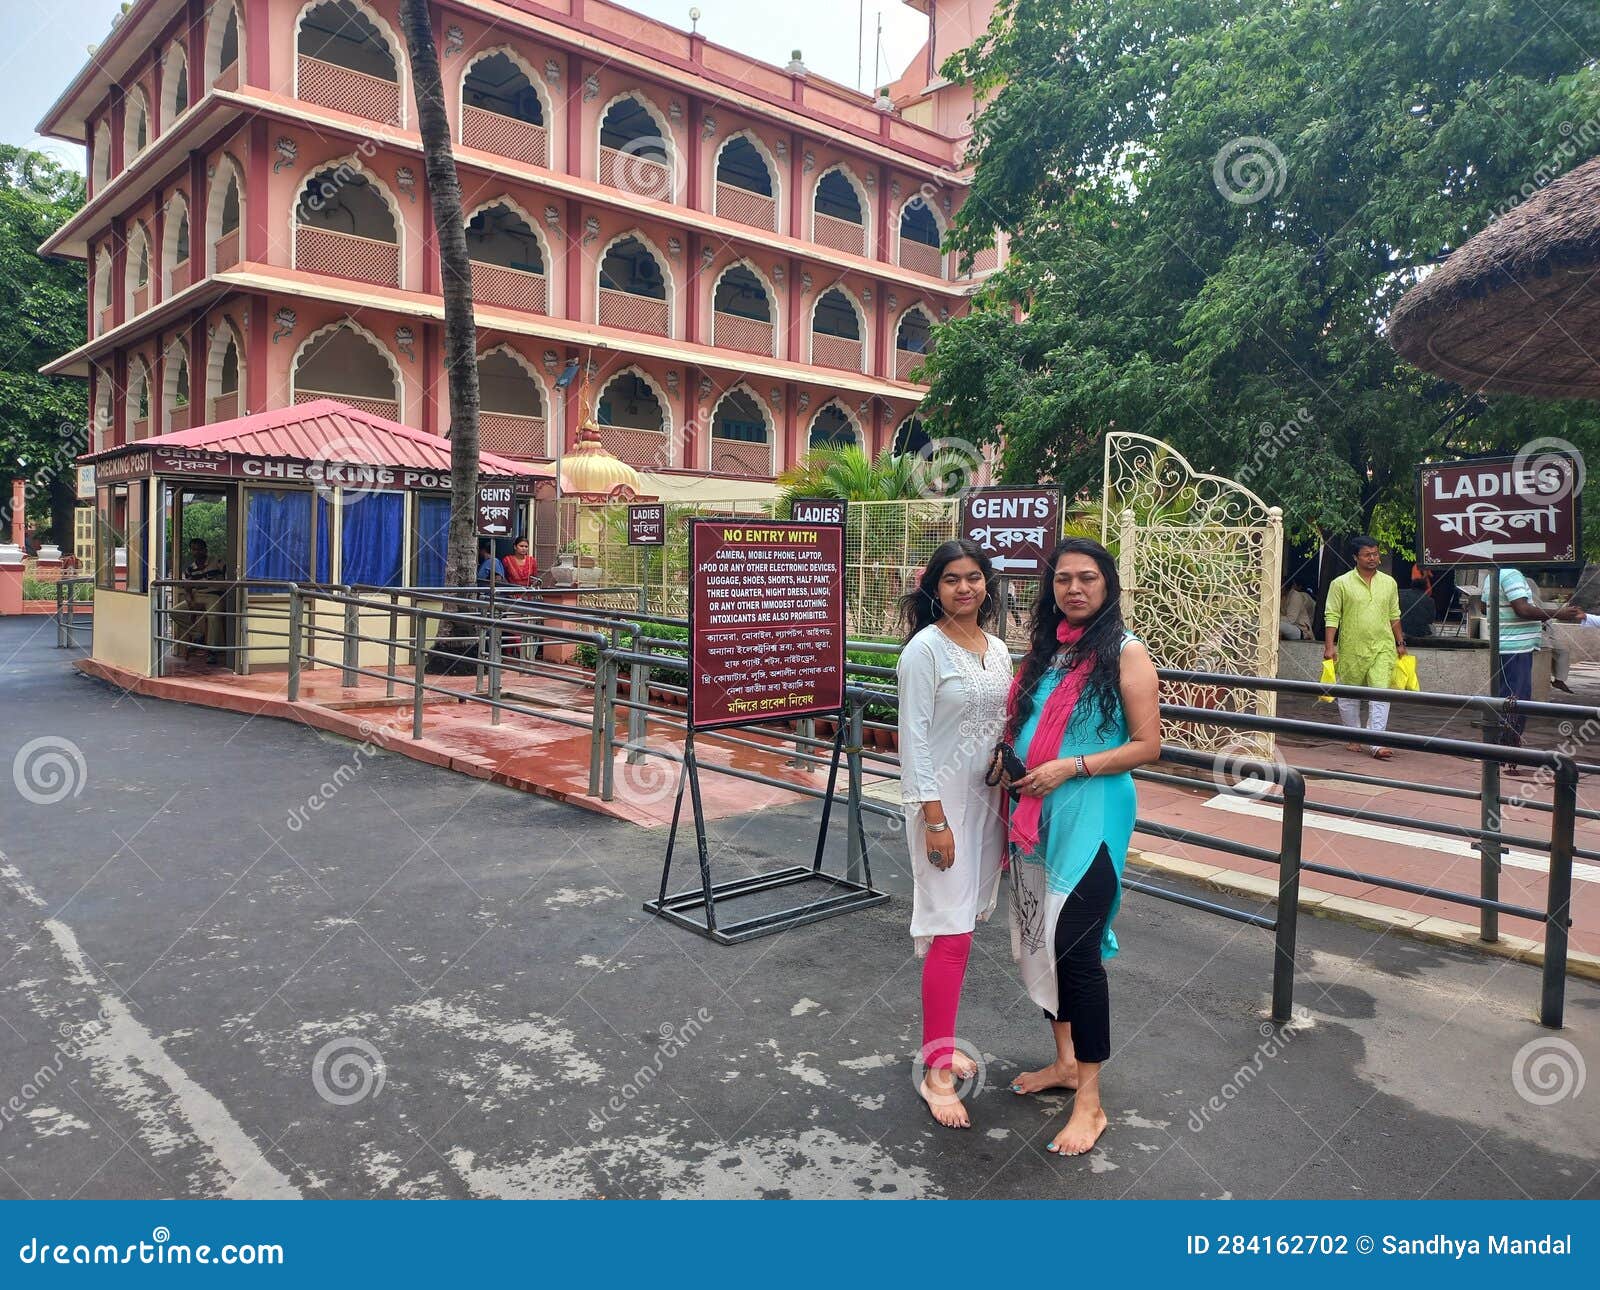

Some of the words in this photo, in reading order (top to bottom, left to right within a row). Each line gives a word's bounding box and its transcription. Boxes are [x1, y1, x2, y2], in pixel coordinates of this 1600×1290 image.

[96, 456, 130, 478] CHECKING
[130, 452, 149, 472] POST
[242, 460, 395, 484] CHECKING
[404, 472, 452, 488] POS
[1434, 468, 1560, 500] LADIES
[480, 488, 510, 501] GENTS
[480, 505, 510, 522] পুরুষ
[798, 506, 840, 522] LADIES
[971, 497, 1049, 518] GENTS
[632, 510, 660, 520] LADIES
[1432, 502, 1562, 538] মহিলা
[632, 521, 660, 534] মহিলা
[724, 530, 742, 541] NO
[746, 530, 784, 542] ENTRY
[788, 532, 817, 542] WITH
[969, 524, 1048, 552] পুরুষ
[716, 550, 746, 560] CAMERA,
[748, 551, 772, 560] MOBILE
[774, 551, 796, 560] PHONE,
[700, 563, 718, 572] I-POD
[719, 563, 728, 572] OR
[730, 564, 745, 572] ANY
[746, 563, 768, 572] OTHER
[770, 564, 808, 572] ELECTRONIC
[810, 563, 837, 573] DEVICES,
[707, 576, 740, 586] LUGGAGE,
[742, 576, 766, 586] SHOES,
[768, 576, 796, 585] SHORTS,
[796, 576, 812, 584] HALF
[814, 576, 830, 584] PANT,
[707, 589, 729, 598] THREE
[730, 588, 764, 598] QUARTER,
[766, 588, 785, 596] NIGHT
[788, 588, 810, 596] DRESS,
[710, 602, 720, 610] OR
[721, 602, 736, 610] ANY
[736, 601, 760, 610] OTHER
[762, 600, 795, 609] IMMODEST
[796, 599, 828, 608] CLOTHING.
[710, 614, 756, 624] INTOXICANTS
[758, 613, 771, 622] ARE
[772, 612, 789, 621] ALSO
[790, 611, 828, 620] PROHIBITED.
